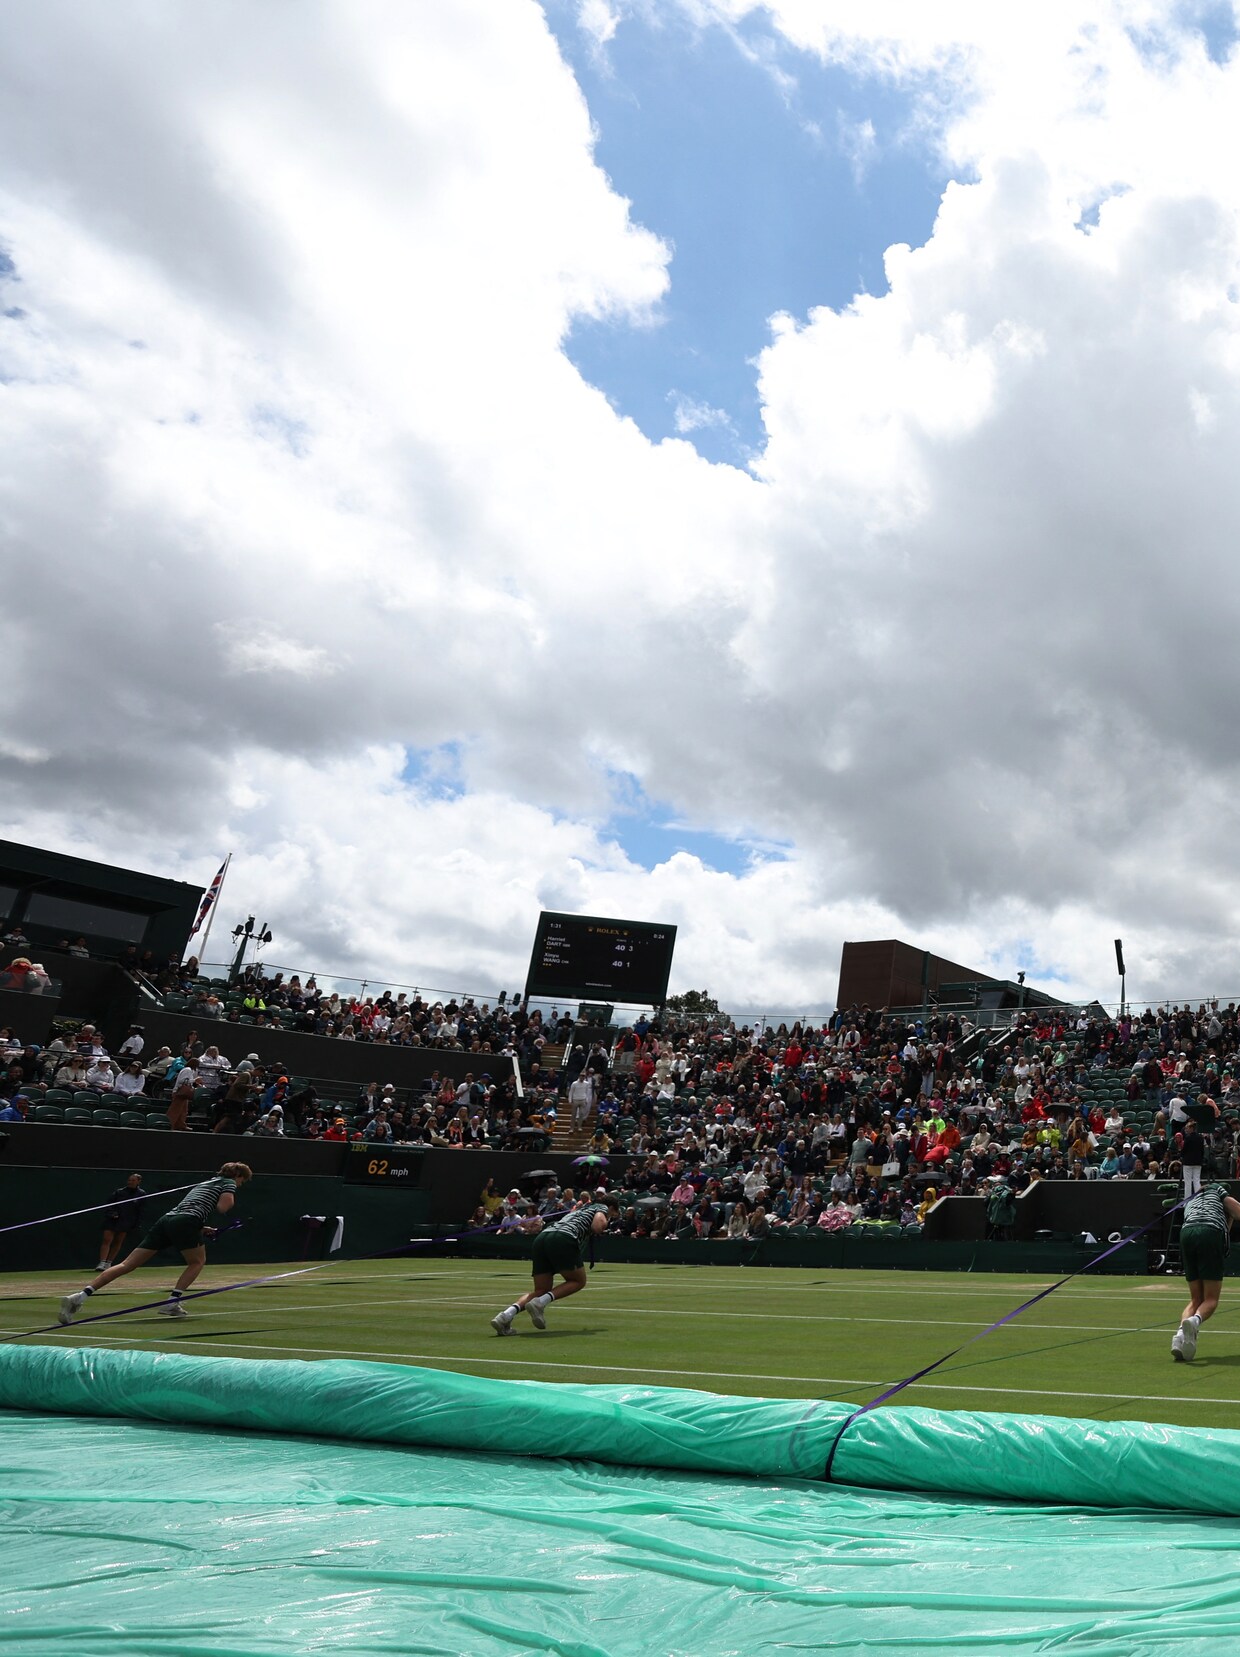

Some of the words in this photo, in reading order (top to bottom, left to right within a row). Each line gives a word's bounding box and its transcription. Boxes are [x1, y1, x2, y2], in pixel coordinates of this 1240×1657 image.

[596, 927, 620, 935] ROLEX
[351, 1143, 369, 1152] IBM
[368, 1159, 389, 1175] 62
[390, 1167, 409, 1177] mph
